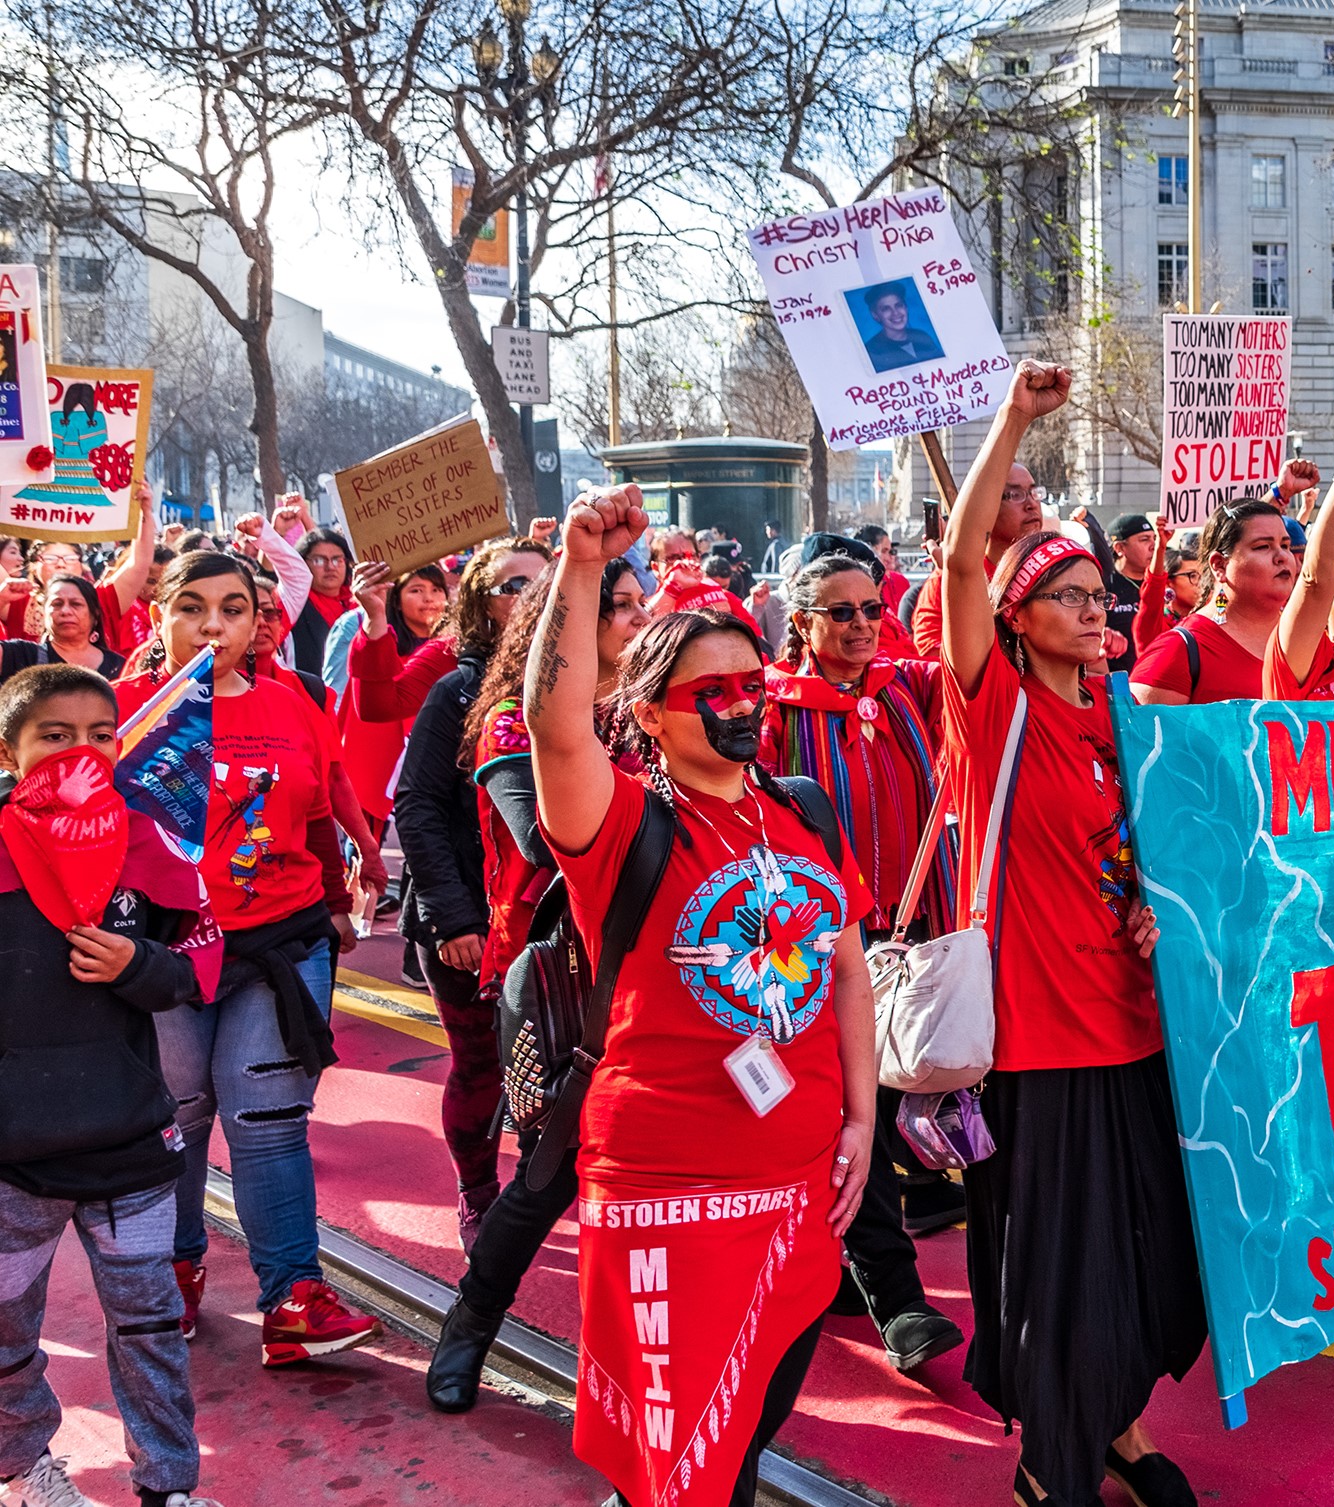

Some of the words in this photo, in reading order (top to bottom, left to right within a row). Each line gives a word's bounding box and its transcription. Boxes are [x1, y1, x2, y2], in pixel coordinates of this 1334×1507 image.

[510, 336, 531, 346] BUS
[1171, 321, 1197, 347] TOO
[1198, 321, 1234, 349] MANY
[1235, 321, 1288, 350] MOTHERS
[509, 360, 534, 369] TAXI
[510, 349, 533, 358] AND
[1171, 351, 1196, 378] TOO
[1198, 351, 1234, 379] MANY
[1235, 354, 1283, 380] SISTERS
[504, 384, 541, 394] AHEAD
[506, 373, 536, 382] LANE
[94, 380, 139, 416] MORE
[1170, 381, 1195, 407] TOO
[1196, 382, 1234, 407] MANY
[1235, 382, 1285, 408] AUNTIES
[1169, 411, 1194, 438] TOO
[1195, 411, 1232, 439] MANY
[1232, 409, 1287, 438] DAUGHTERS
[351, 452, 424, 500] REMBER
[427, 436, 460, 460] THE
[1171, 439, 1282, 485] STOLEN
[354, 482, 415, 522] HEARTS
[422, 472, 437, 492] OF
[446, 460, 477, 482] OUR
[397, 485, 463, 526] SISTERS
[1166, 488, 1201, 524] NOT
[10, 503, 95, 524] #mmiw
[362, 544, 384, 564] NO
[385, 524, 433, 561] MORE
[437, 496, 499, 537] #MMIW
[1006, 550, 1050, 601] MORE
[1049, 539, 1085, 555] STO
[166, 802, 196, 830] CHOICE
[580, 1203, 602, 1228] ORE
[607, 1199, 700, 1228] STOLEN
[706, 1188, 797, 1220] SISTARS
[629, 1247, 675, 1452] MMIW
